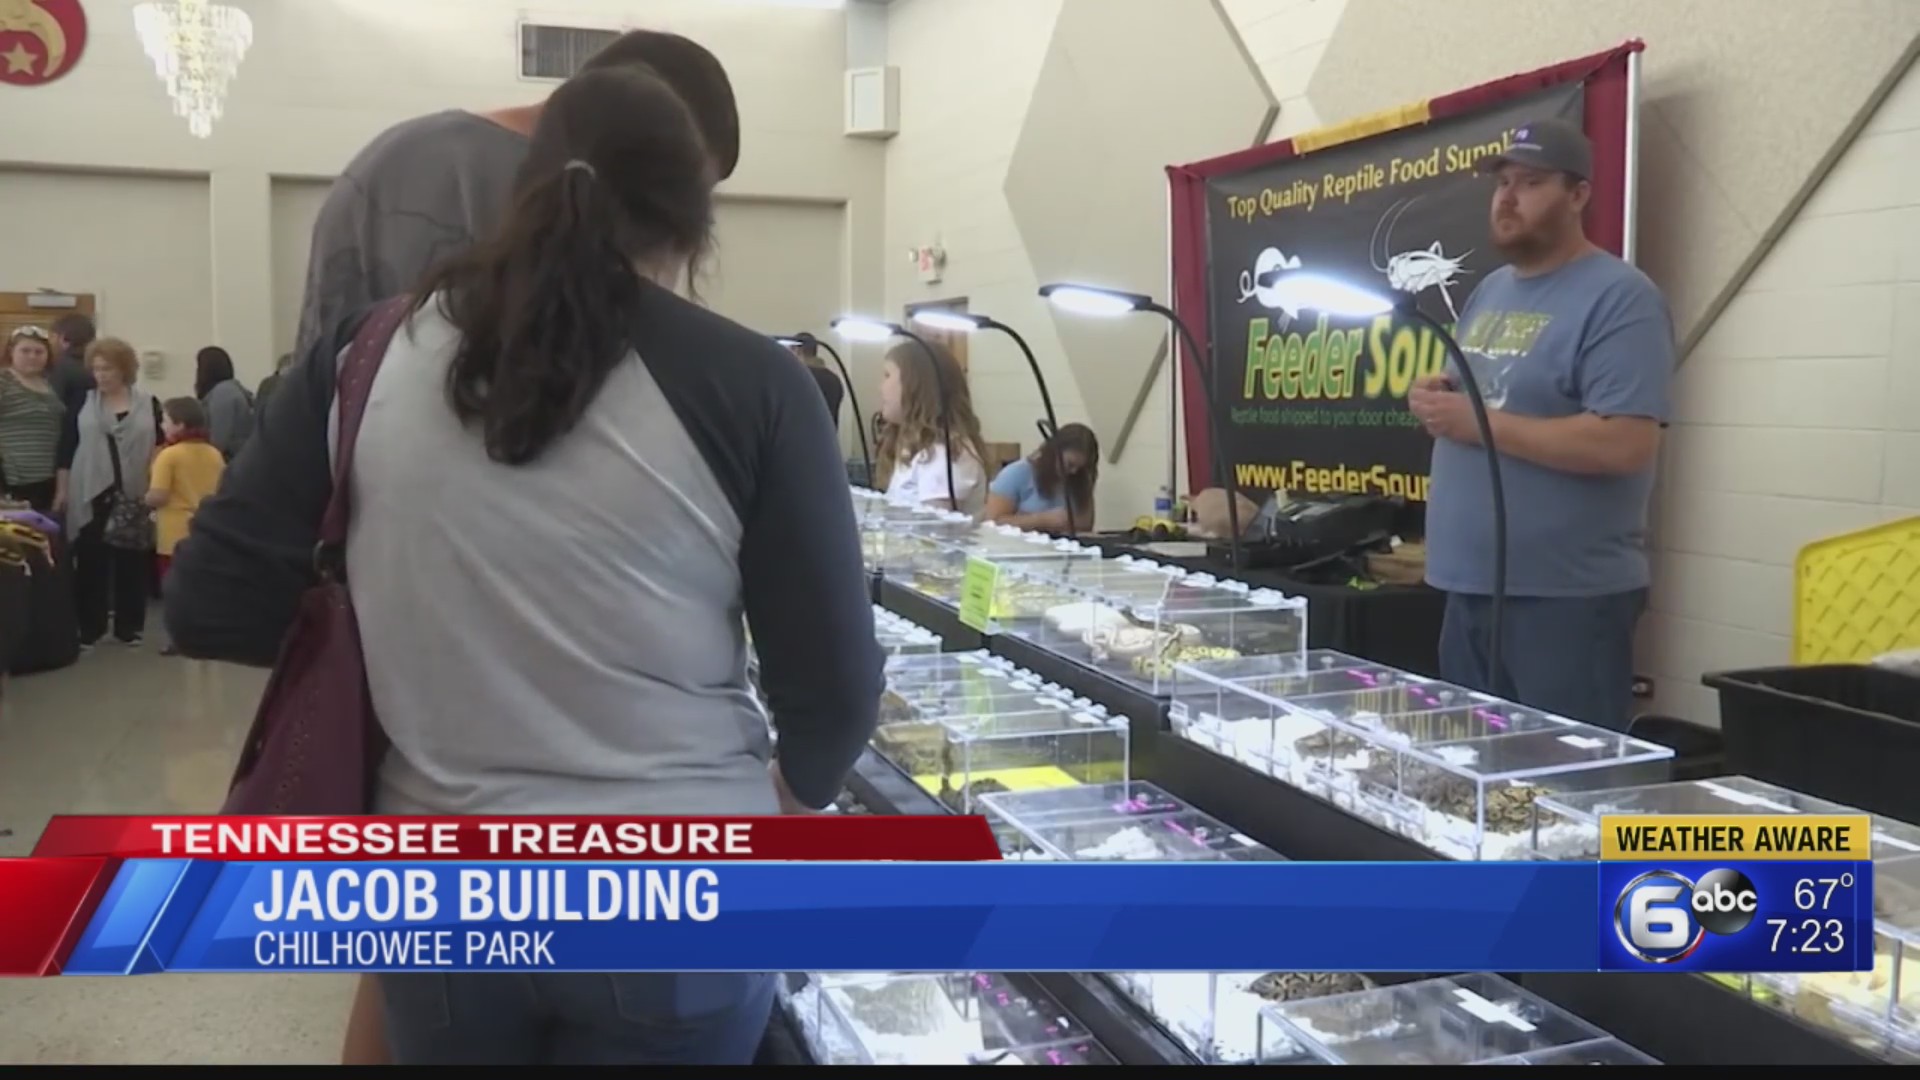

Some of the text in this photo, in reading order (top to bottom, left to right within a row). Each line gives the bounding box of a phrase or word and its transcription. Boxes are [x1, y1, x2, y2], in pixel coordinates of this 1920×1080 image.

[1228, 196, 1255, 223] Top
[1259, 178, 1319, 212] Quality
[1323, 163, 1385, 203] Reptile
[1389, 147, 1440, 183] Food
[1244, 311, 1364, 399] Feeder
[1364, 314, 1457, 398] Sou
[1259, 406, 1279, 425] food
[1281, 406, 1319, 427] shipped
[1320, 407, 1331, 424] to
[1332, 410, 1356, 428] your
[1358, 406, 1383, 426] door
